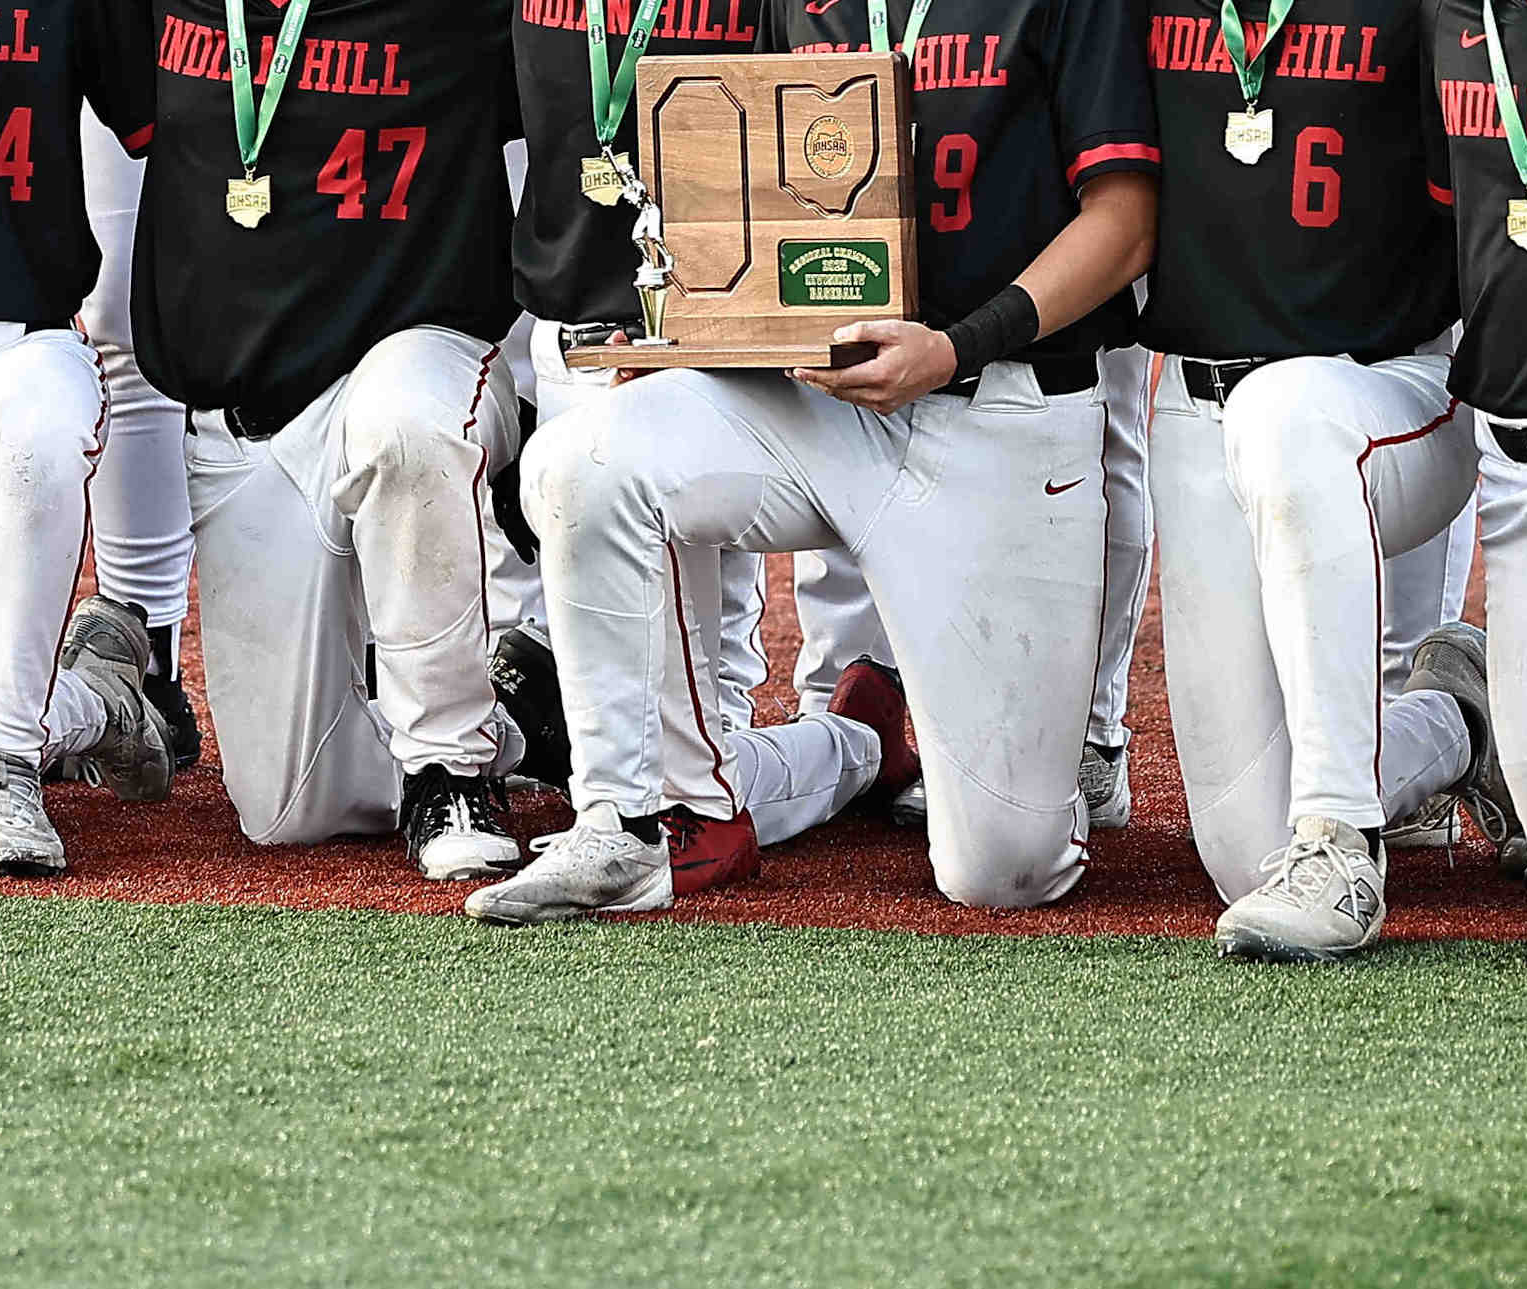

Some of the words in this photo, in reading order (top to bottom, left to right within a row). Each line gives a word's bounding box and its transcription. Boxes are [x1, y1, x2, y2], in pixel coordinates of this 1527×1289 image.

[297, 39, 410, 96] HILL
[914, 34, 1008, 92] HILL
[1275, 24, 1386, 82] HILL
[317, 128, 427, 221] 47
[815, 140, 845, 153] OHSAA
[931, 133, 978, 232] 9
[1292, 127, 1344, 228] 6
[809, 286, 863, 300] BASEBALL
